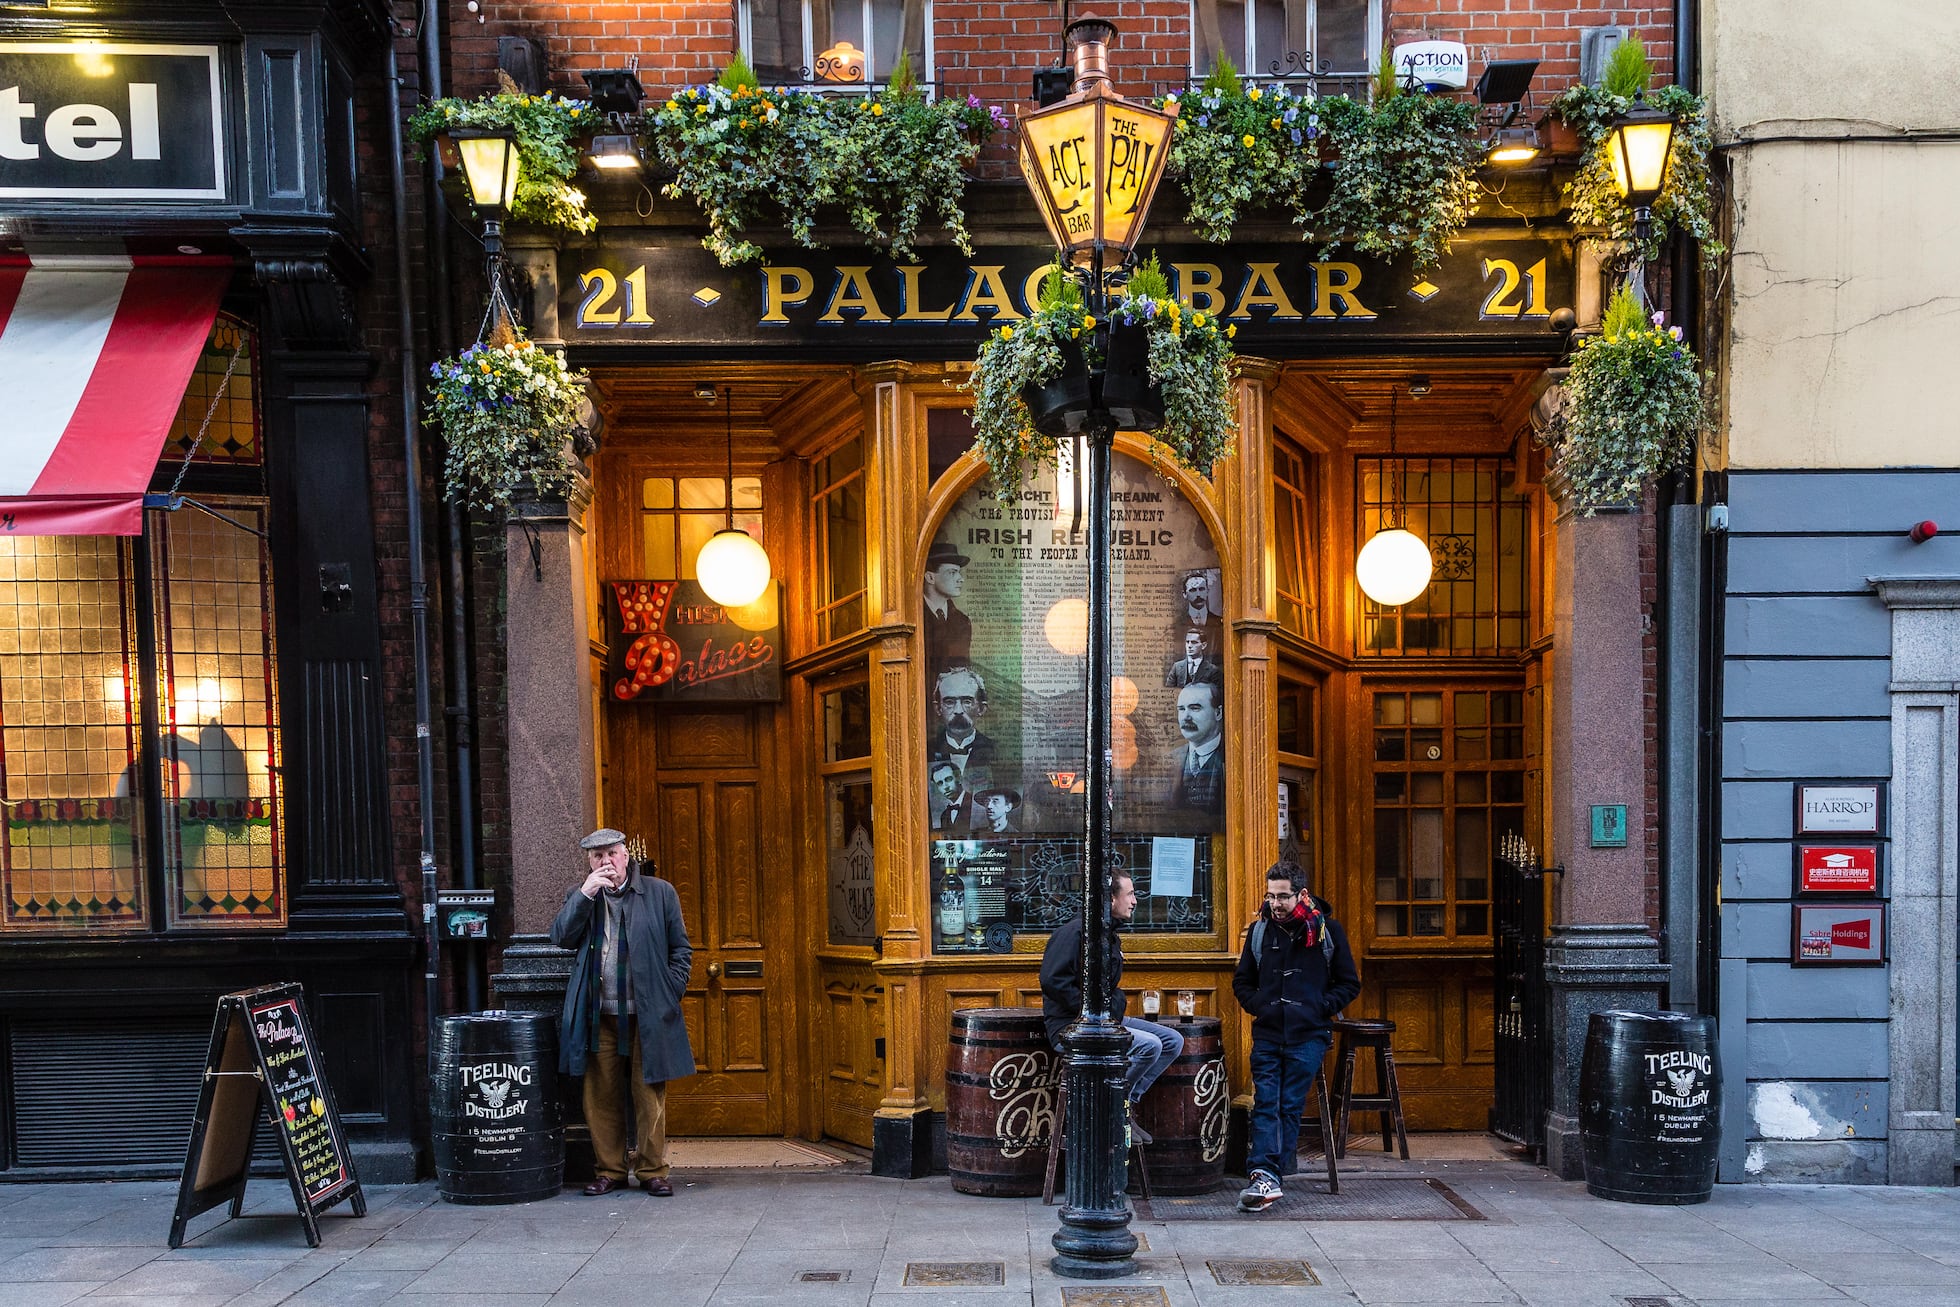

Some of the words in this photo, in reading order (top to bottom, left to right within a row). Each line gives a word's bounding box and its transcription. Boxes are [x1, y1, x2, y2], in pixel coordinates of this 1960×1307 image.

[1401, 53, 1463, 66] ACTION
[1112, 116, 1139, 137] THE
[1049, 135, 1091, 192] ACE
[1068, 213, 1092, 235] BAR
[577, 264, 656, 329] 21
[1168, 261, 1379, 322] BAR
[1478, 257, 1552, 321] 21
[980, 507, 1003, 520] THE
[967, 527, 1033, 545] IRISH
[990, 547, 1005, 560] TO
[1012, 547, 1033, 560] THE
[1040, 547, 1079, 560] PEOPLE
[614, 634, 773, 700] Palace
[1806, 801, 1874, 814] HARROP
[850, 855, 871, 880] THE
[980, 875, 993, 886] 14
[1833, 929, 1868, 939] Holdings
[1644, 1050, 1712, 1075] TEELING
[459, 1062, 532, 1087] TEELING
